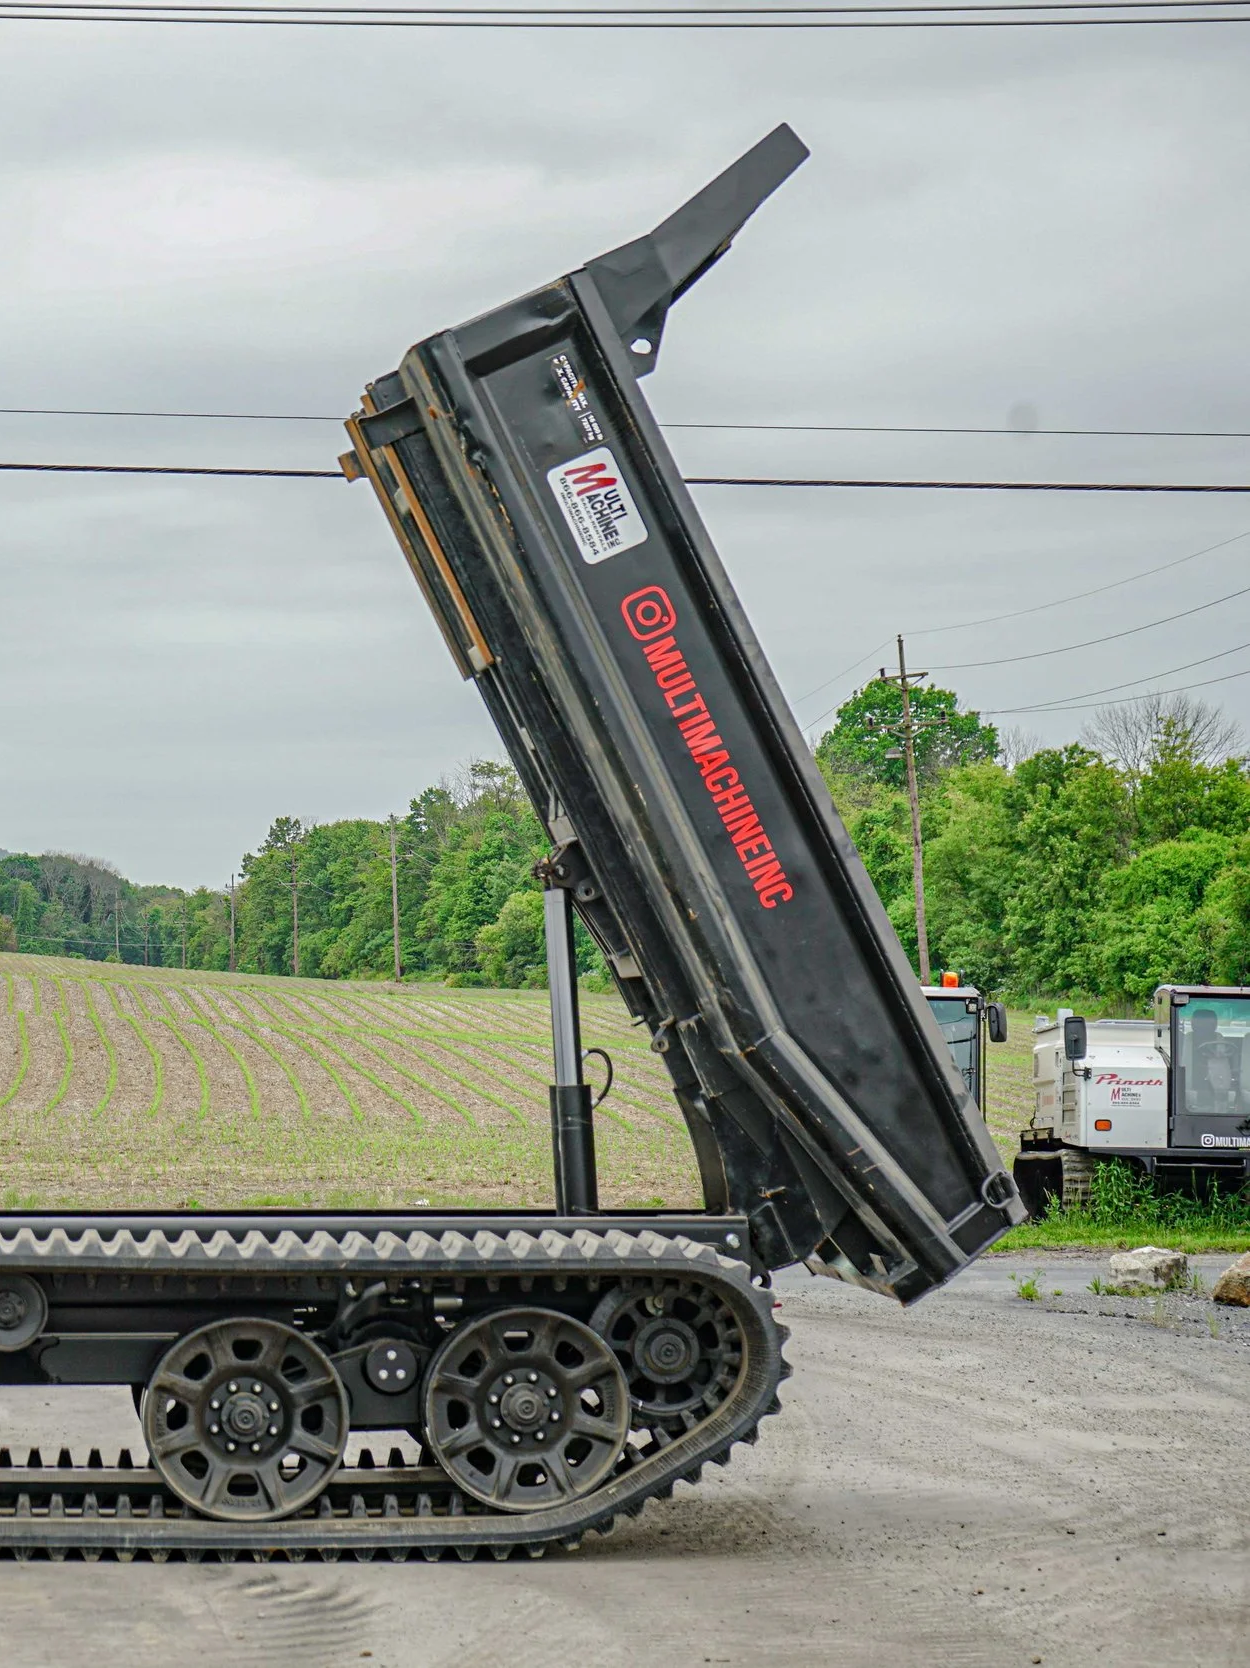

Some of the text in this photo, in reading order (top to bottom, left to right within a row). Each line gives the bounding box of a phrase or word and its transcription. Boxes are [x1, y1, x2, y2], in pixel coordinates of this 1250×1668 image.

[559, 477, 600, 555] 866-866-8584
[642, 635, 794, 909] MULTIMACHINEINC
[1093, 1073, 1163, 1085] Prinoth
